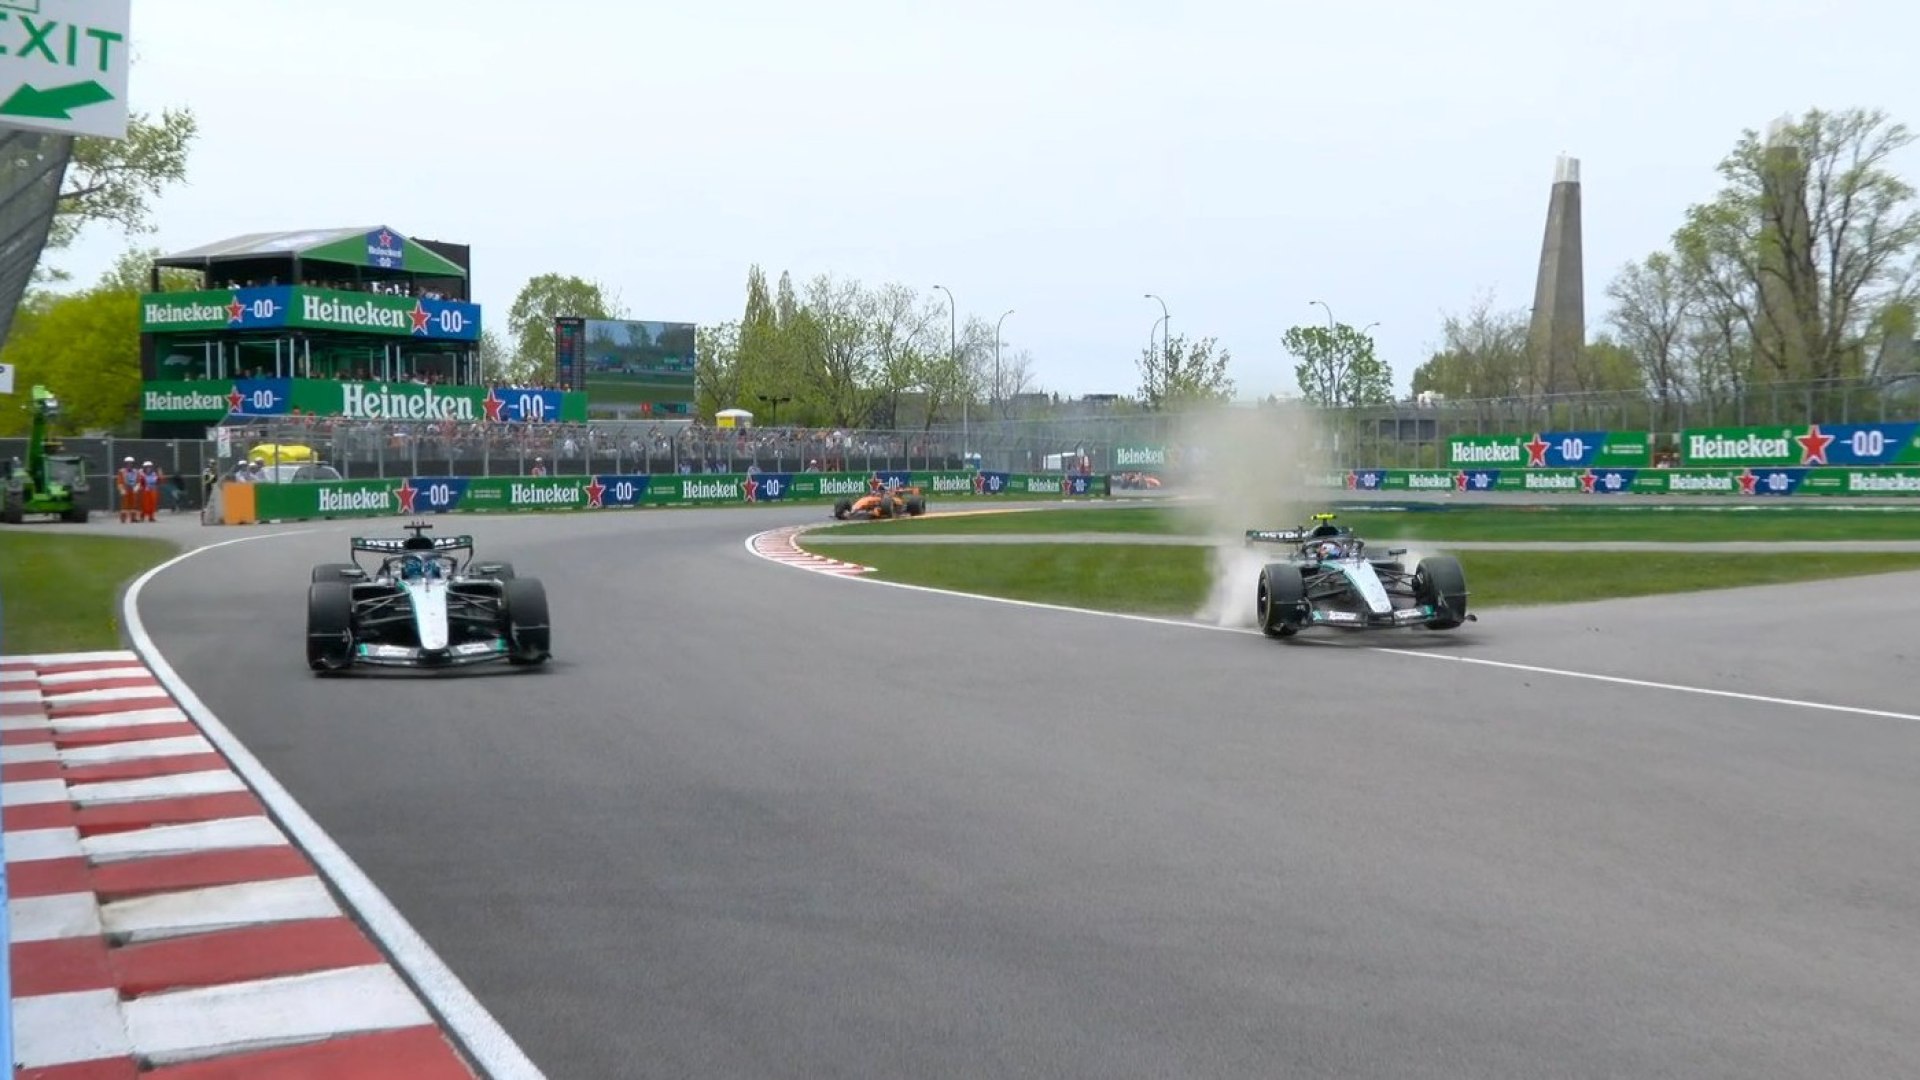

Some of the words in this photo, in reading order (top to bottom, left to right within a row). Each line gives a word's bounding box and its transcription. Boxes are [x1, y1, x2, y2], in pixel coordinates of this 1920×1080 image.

[0, 11, 123, 72] XIT
[145, 304, 223, 324] Heineken
[253, 299, 273, 318] 0.0
[302, 295, 405, 328] Heineken
[441, 310, 462, 332] 0.0
[145, 388, 223, 410] Heineken
[342, 384, 473, 421] Heineken
[1452, 440, 1520, 462] Heineken
[1689, 435, 1789, 458] Heineken
[1852, 430, 1883, 456] 0.0
[1117, 446, 1165, 465] Heineken
[683, 480, 738, 499] Heineken
[820, 477, 865, 495] Heineken
[933, 475, 970, 491] Heineken
[1028, 478, 1060, 492] Heineken
[1408, 473, 1451, 488] Heineken
[1525, 473, 1576, 488] Heineken
[1669, 474, 1732, 490] Heineken
[319, 486, 390, 512] Heineken
[511, 483, 580, 504] Heineken
